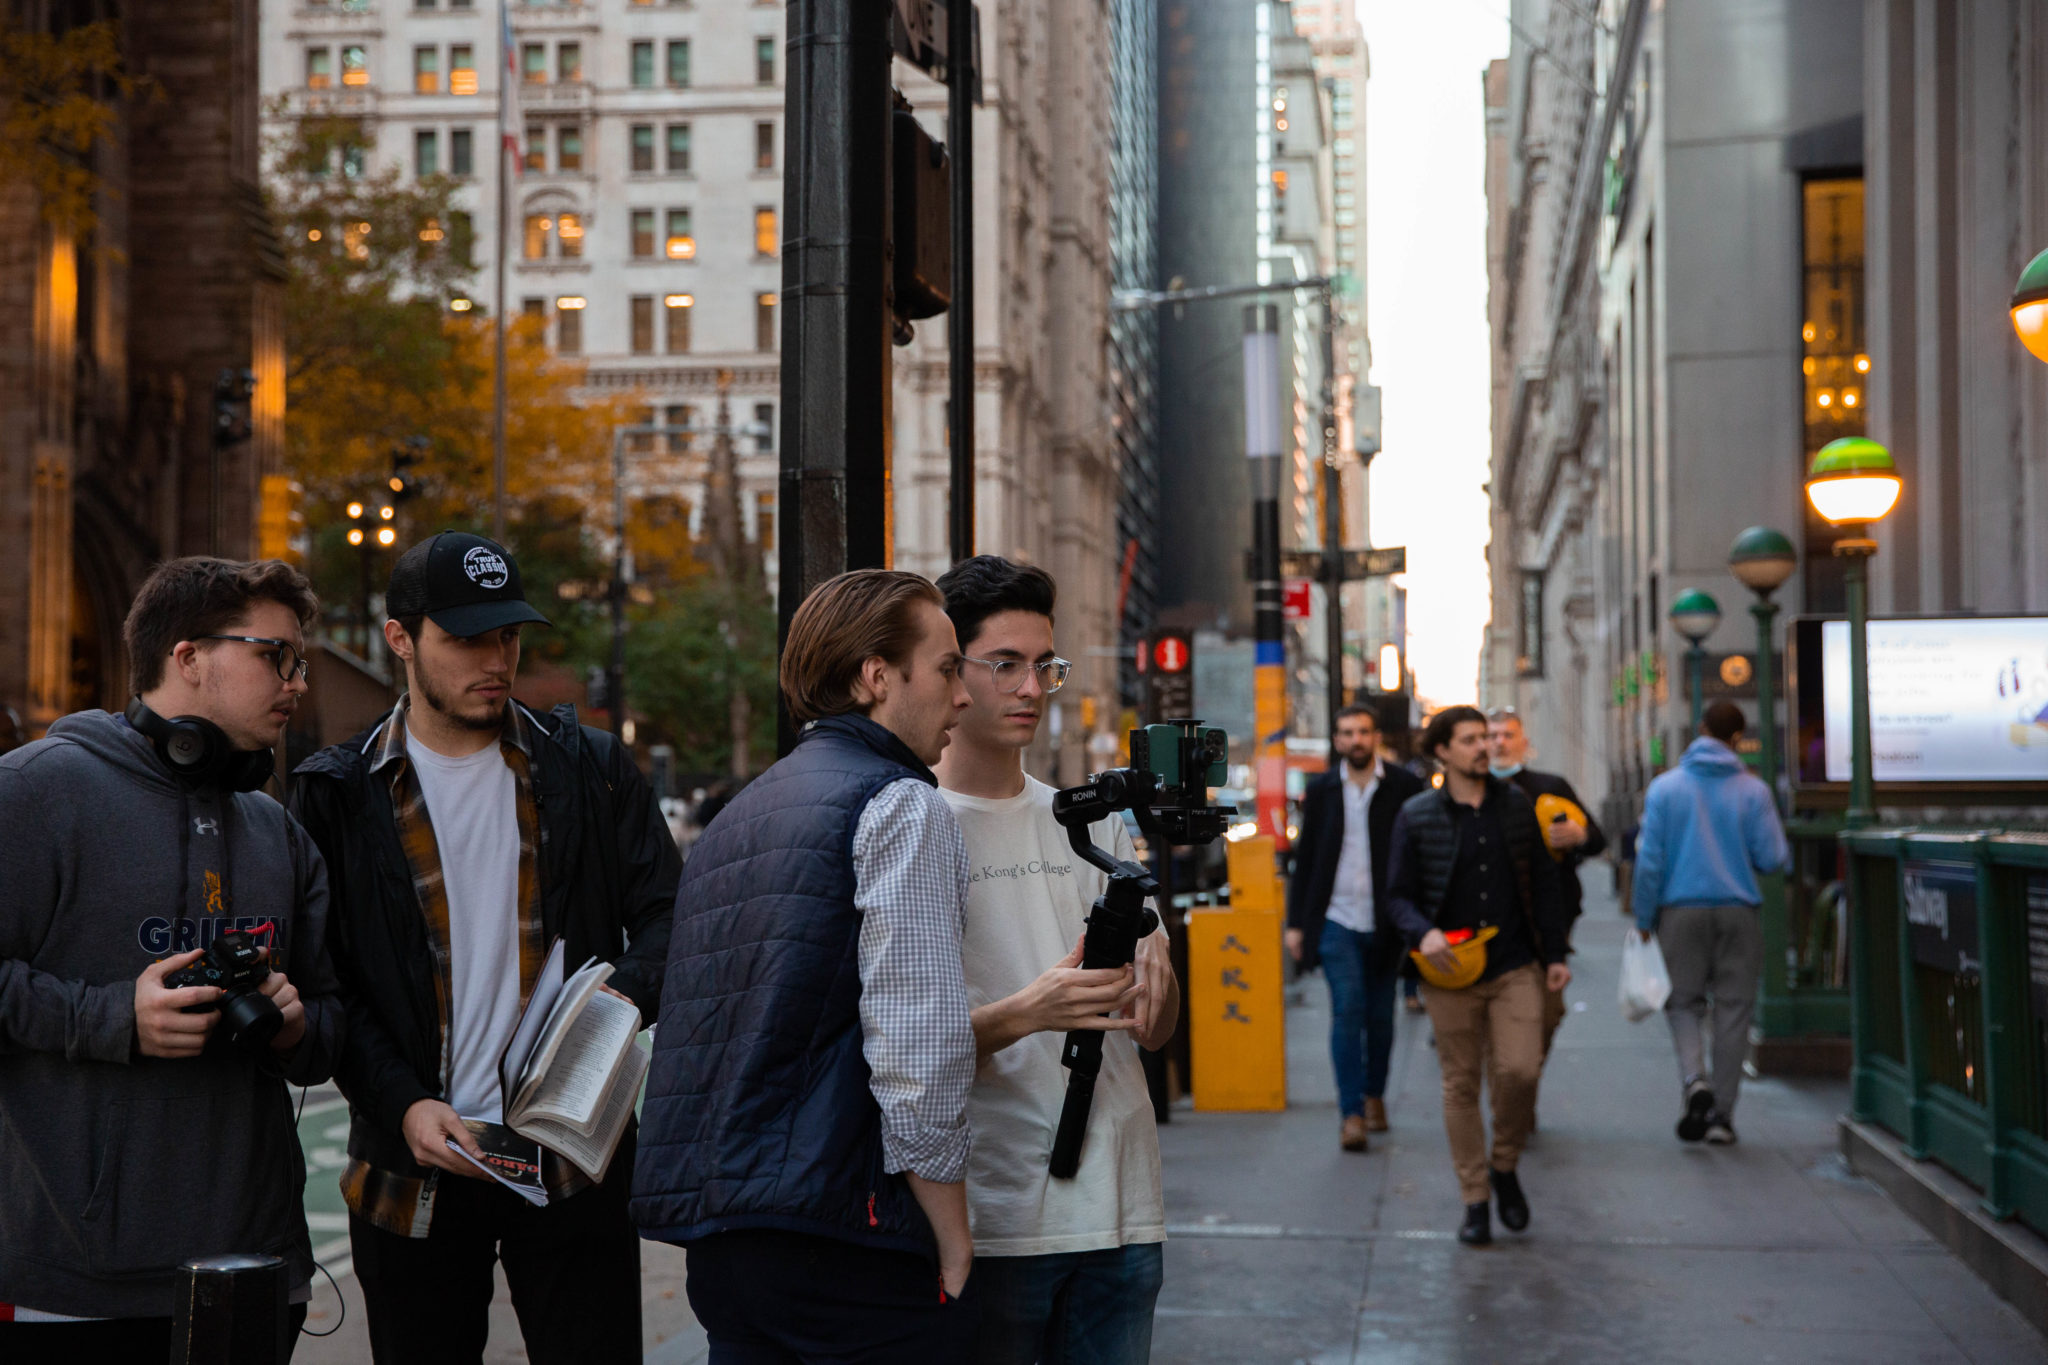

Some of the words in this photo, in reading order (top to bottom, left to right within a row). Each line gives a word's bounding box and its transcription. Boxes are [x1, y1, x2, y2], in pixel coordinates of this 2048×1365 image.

[474, 556, 497, 564] TRUE
[468, 563, 506, 577] CLASSIC
[1072, 789, 1097, 802] RONIN
